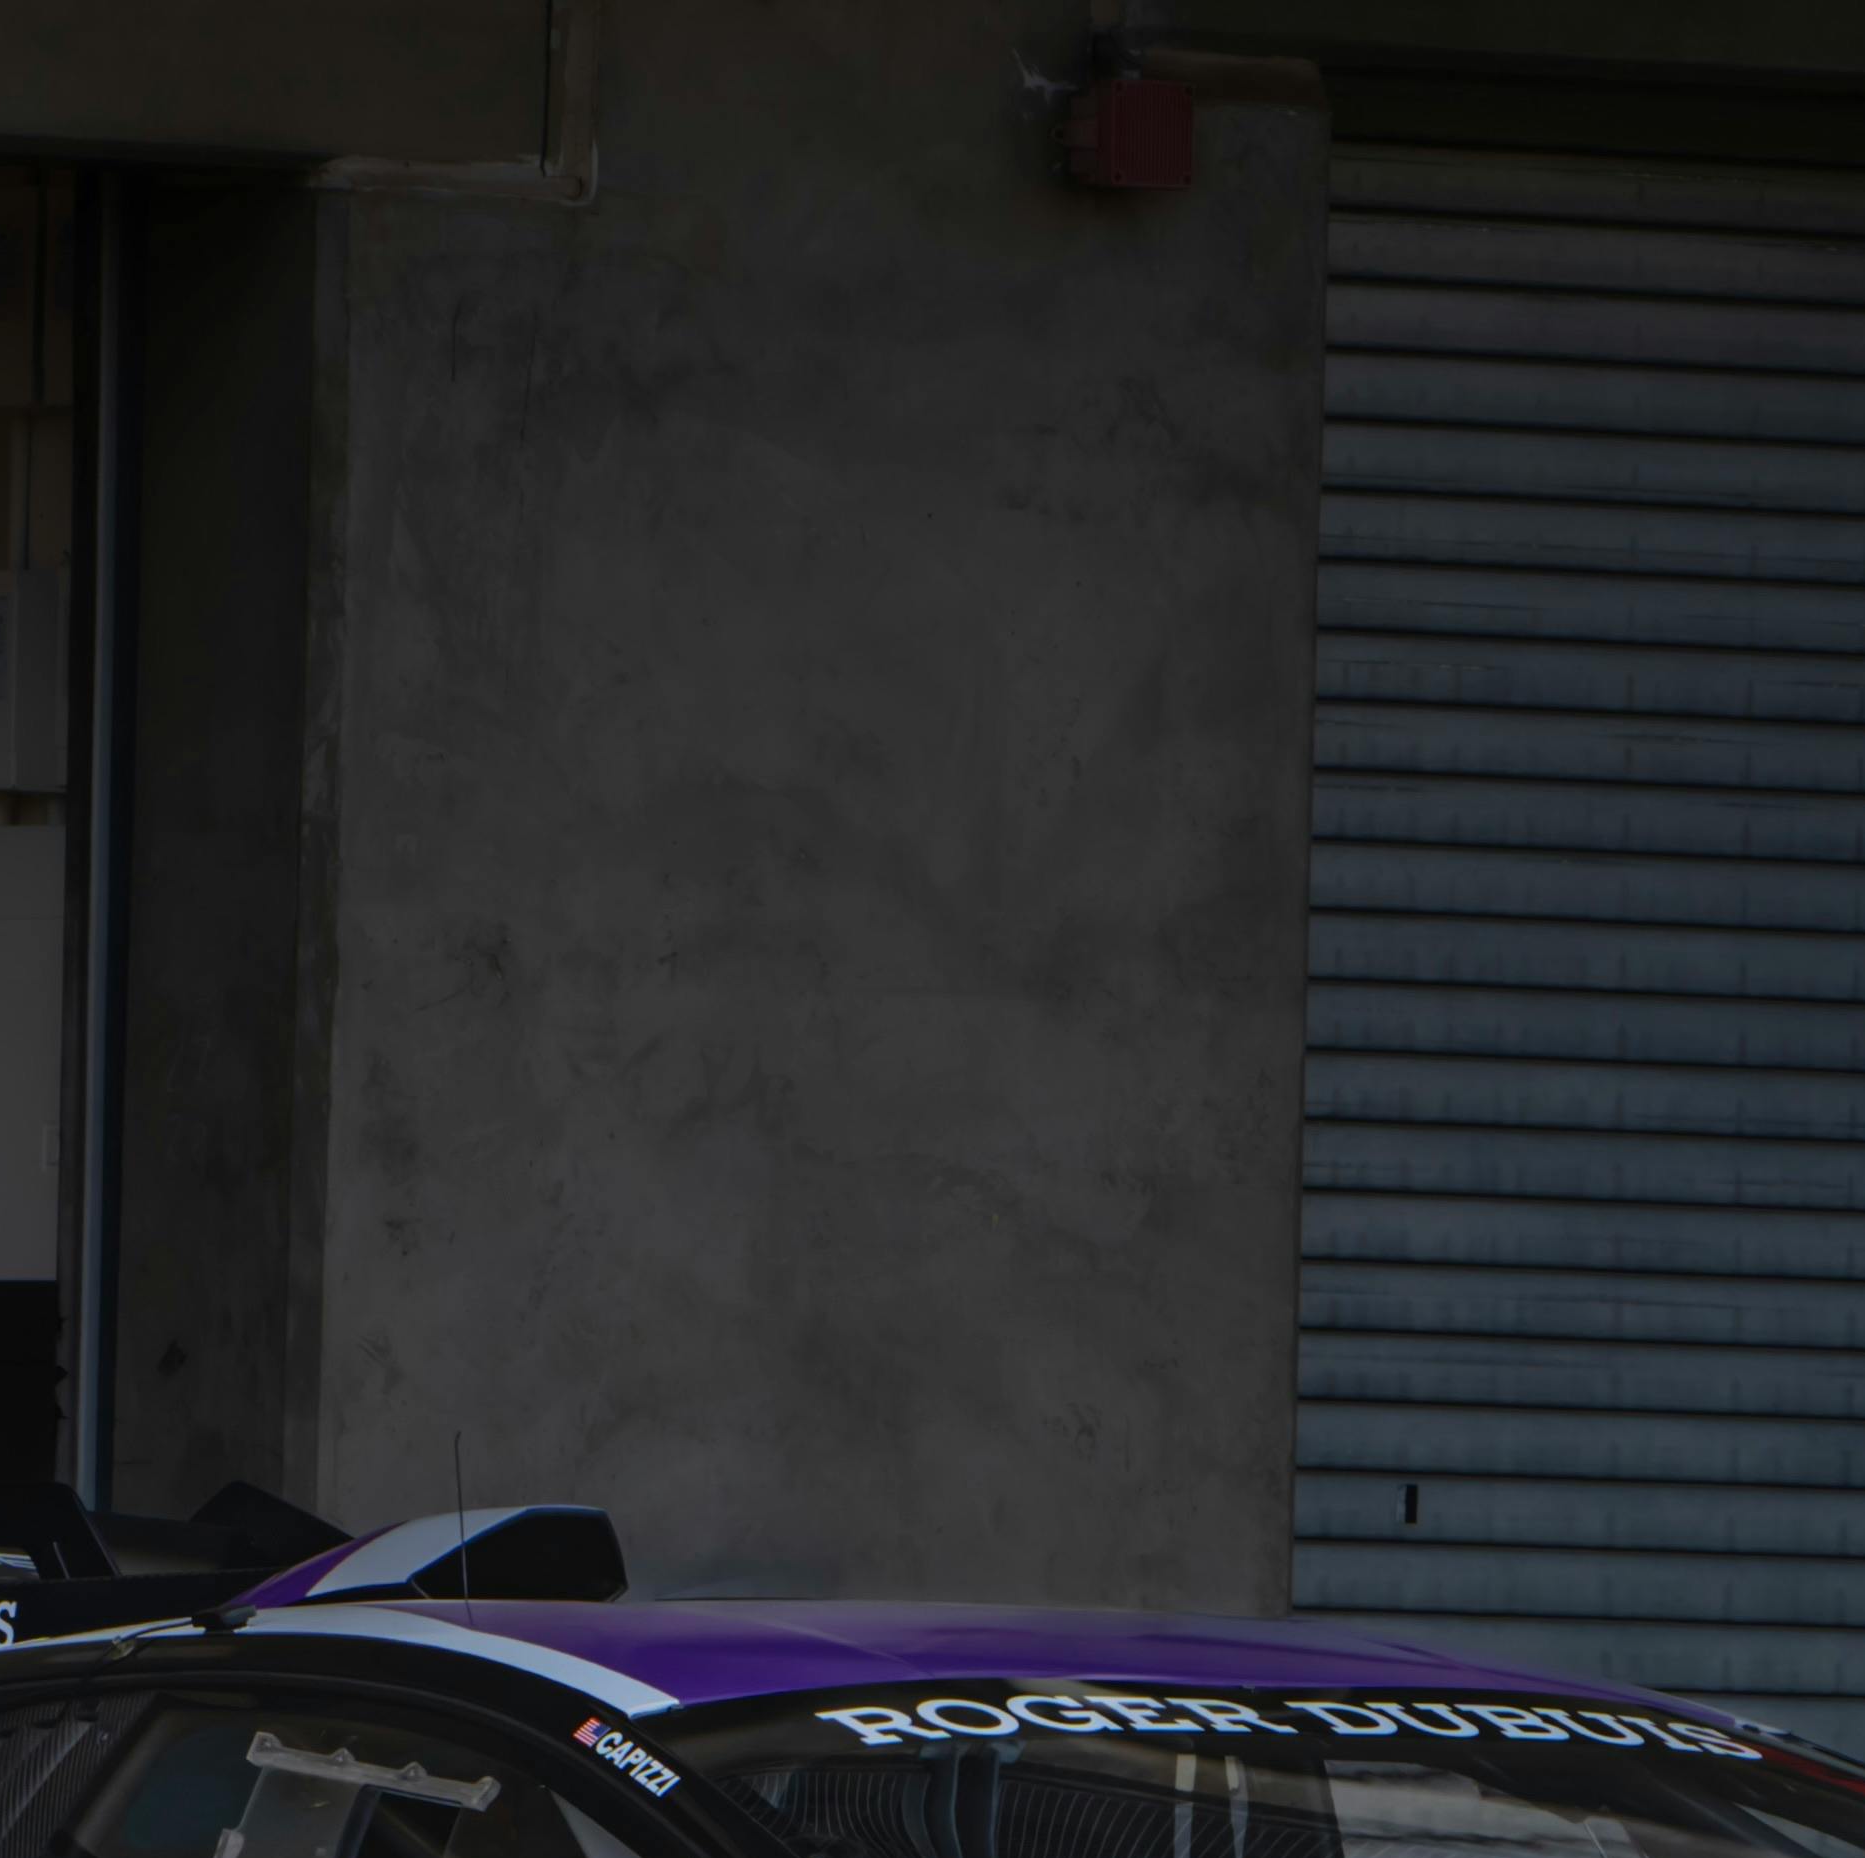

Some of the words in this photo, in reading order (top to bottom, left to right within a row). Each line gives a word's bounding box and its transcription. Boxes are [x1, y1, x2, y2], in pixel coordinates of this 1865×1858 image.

[817, 1693, 1298, 1746] ROGER
[1299, 1698, 1764, 1760] DUBUIS
[595, 1730, 681, 1798] CAPIZZI
